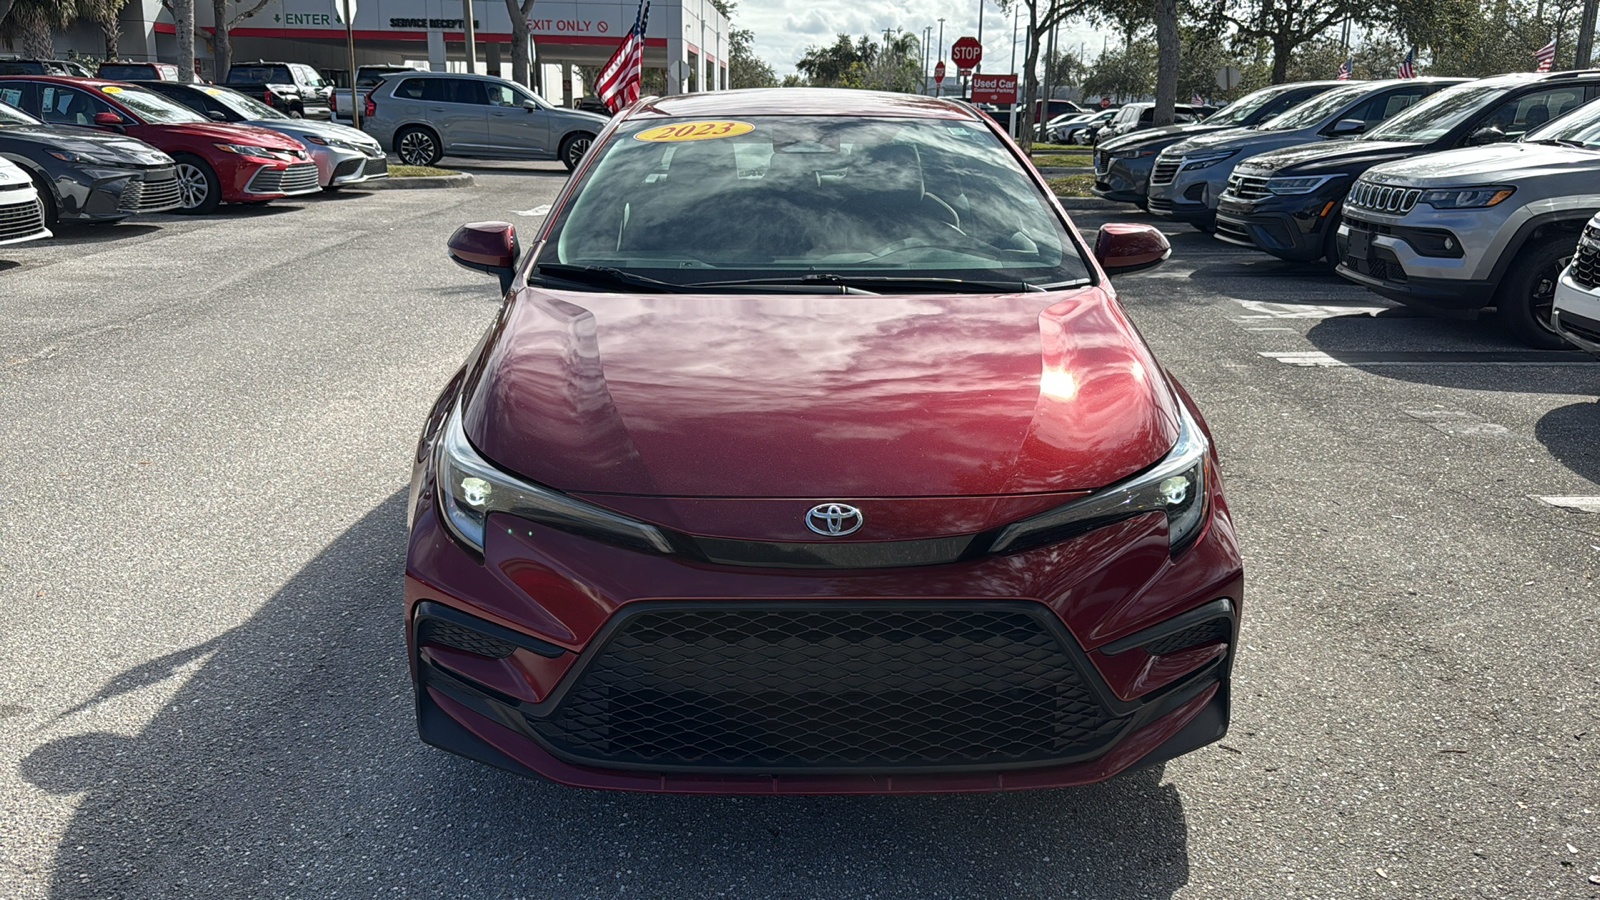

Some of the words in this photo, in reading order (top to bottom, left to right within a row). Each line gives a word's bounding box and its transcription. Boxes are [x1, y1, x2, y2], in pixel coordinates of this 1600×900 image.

[285, 13, 330, 25] ENTER
[389, 18, 428, 28] SERVICE
[429, 18, 479, 29] RECEPTN
[556, 19, 592, 32] ONLY
[953, 47, 980, 60] STOP
[973, 79, 996, 88] Used
[998, 79, 1015, 88] Car
[652, 123, 735, 140] 2023
